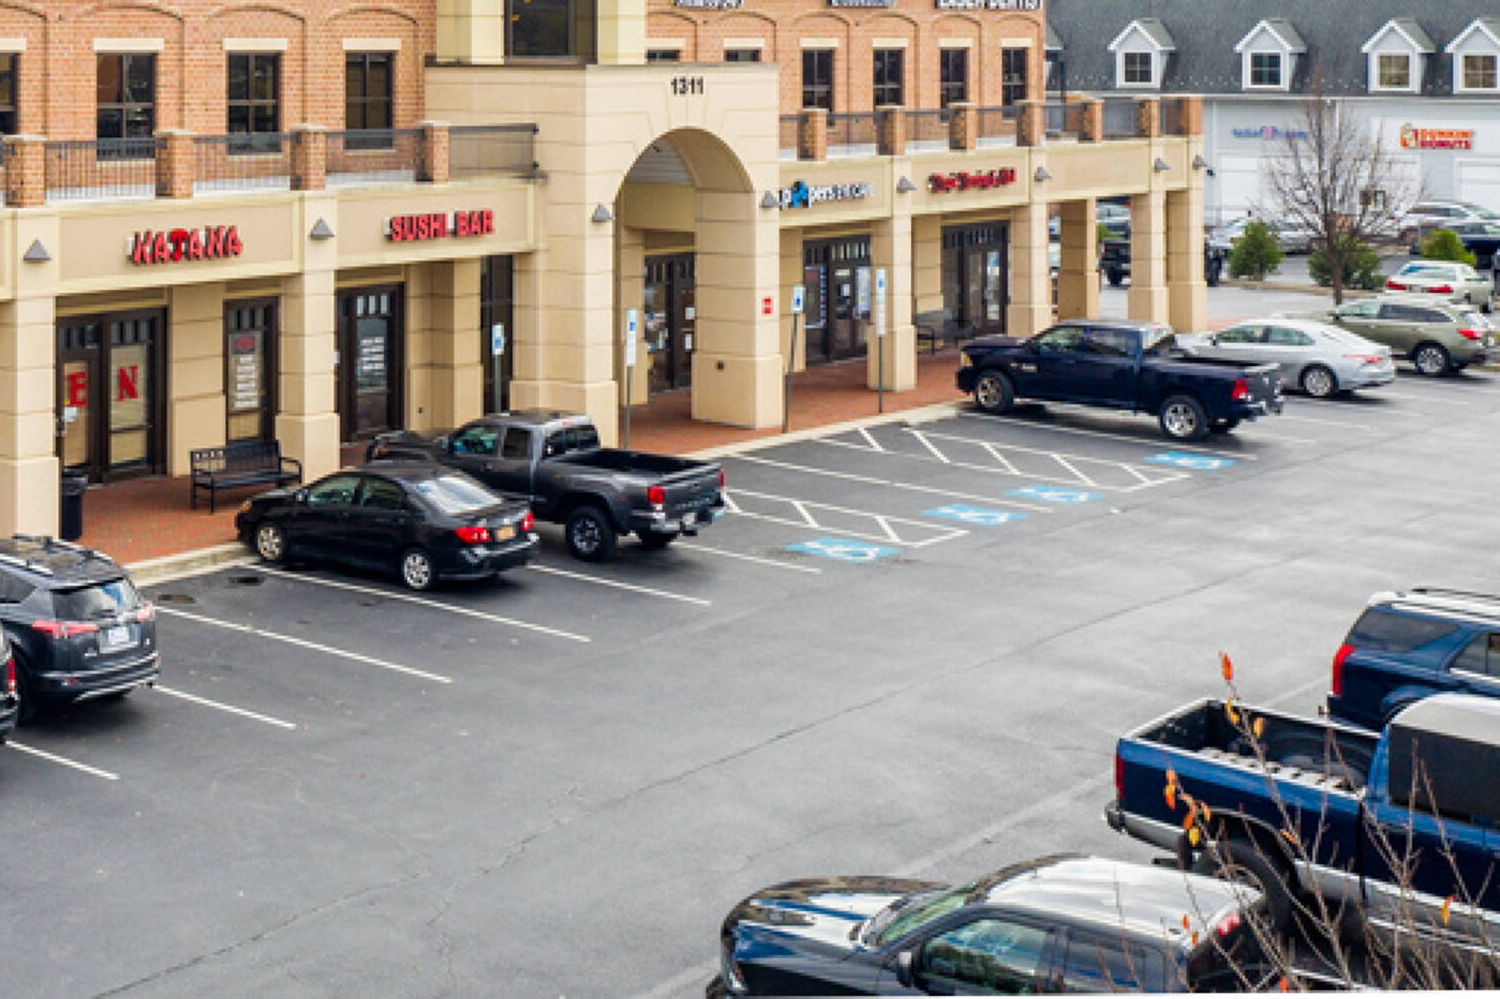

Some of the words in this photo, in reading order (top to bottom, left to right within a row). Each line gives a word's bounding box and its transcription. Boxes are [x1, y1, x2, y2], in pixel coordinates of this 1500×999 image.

[670, 76, 704, 95] 1311
[390, 213, 447, 242] SUSHI
[454, 210, 493, 236] BAR
[131, 225, 242, 265] KATANA
